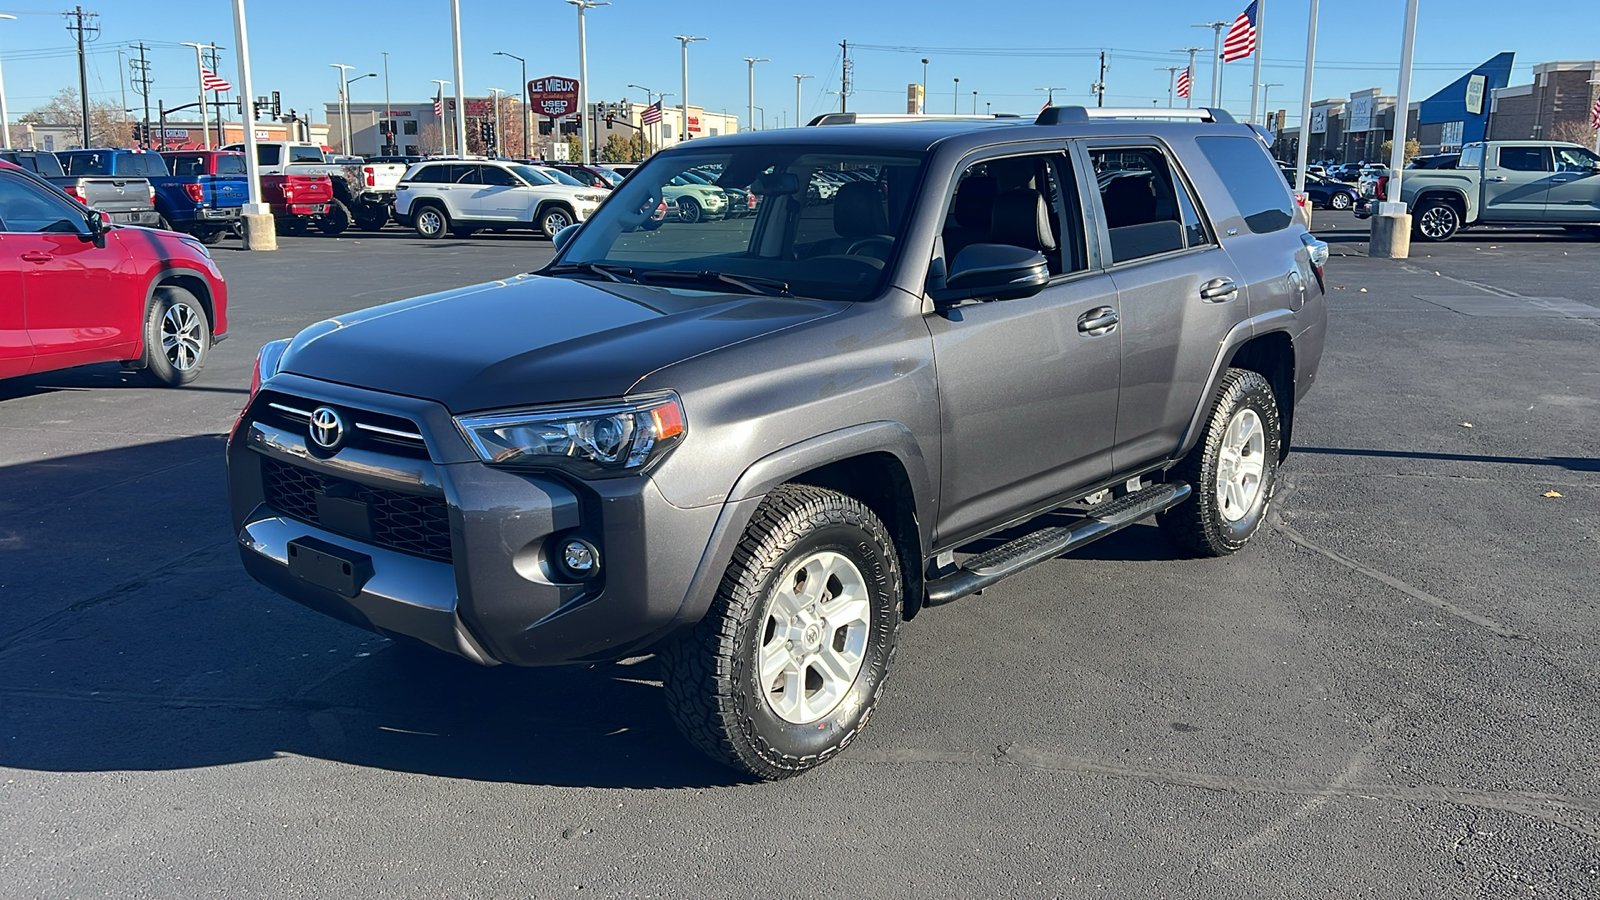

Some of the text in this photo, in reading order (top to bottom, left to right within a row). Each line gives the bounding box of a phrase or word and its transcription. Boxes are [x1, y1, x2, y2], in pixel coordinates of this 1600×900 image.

[532, 79, 574, 92] LE MIEUX
[1469, 81, 1484, 94] BEST
[1468, 94, 1481, 107] BUY
[165, 129, 189, 138] CHICAGO
